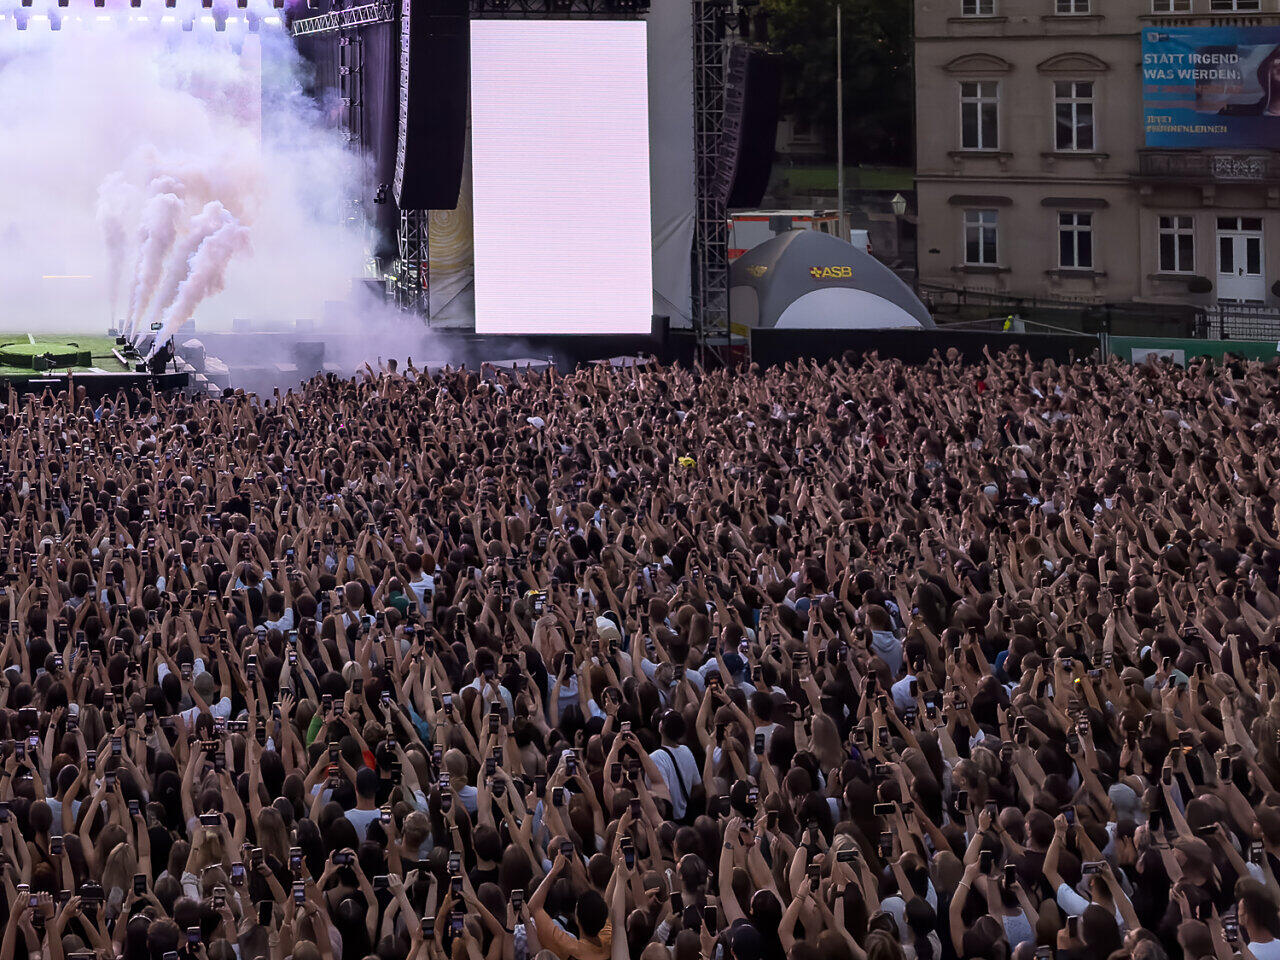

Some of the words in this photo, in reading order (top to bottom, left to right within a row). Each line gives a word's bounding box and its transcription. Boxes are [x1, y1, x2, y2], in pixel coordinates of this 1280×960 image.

[1144, 53, 1185, 64] STATT
[1144, 69, 1175, 79] WAS
[821, 266, 853, 278] ASB
